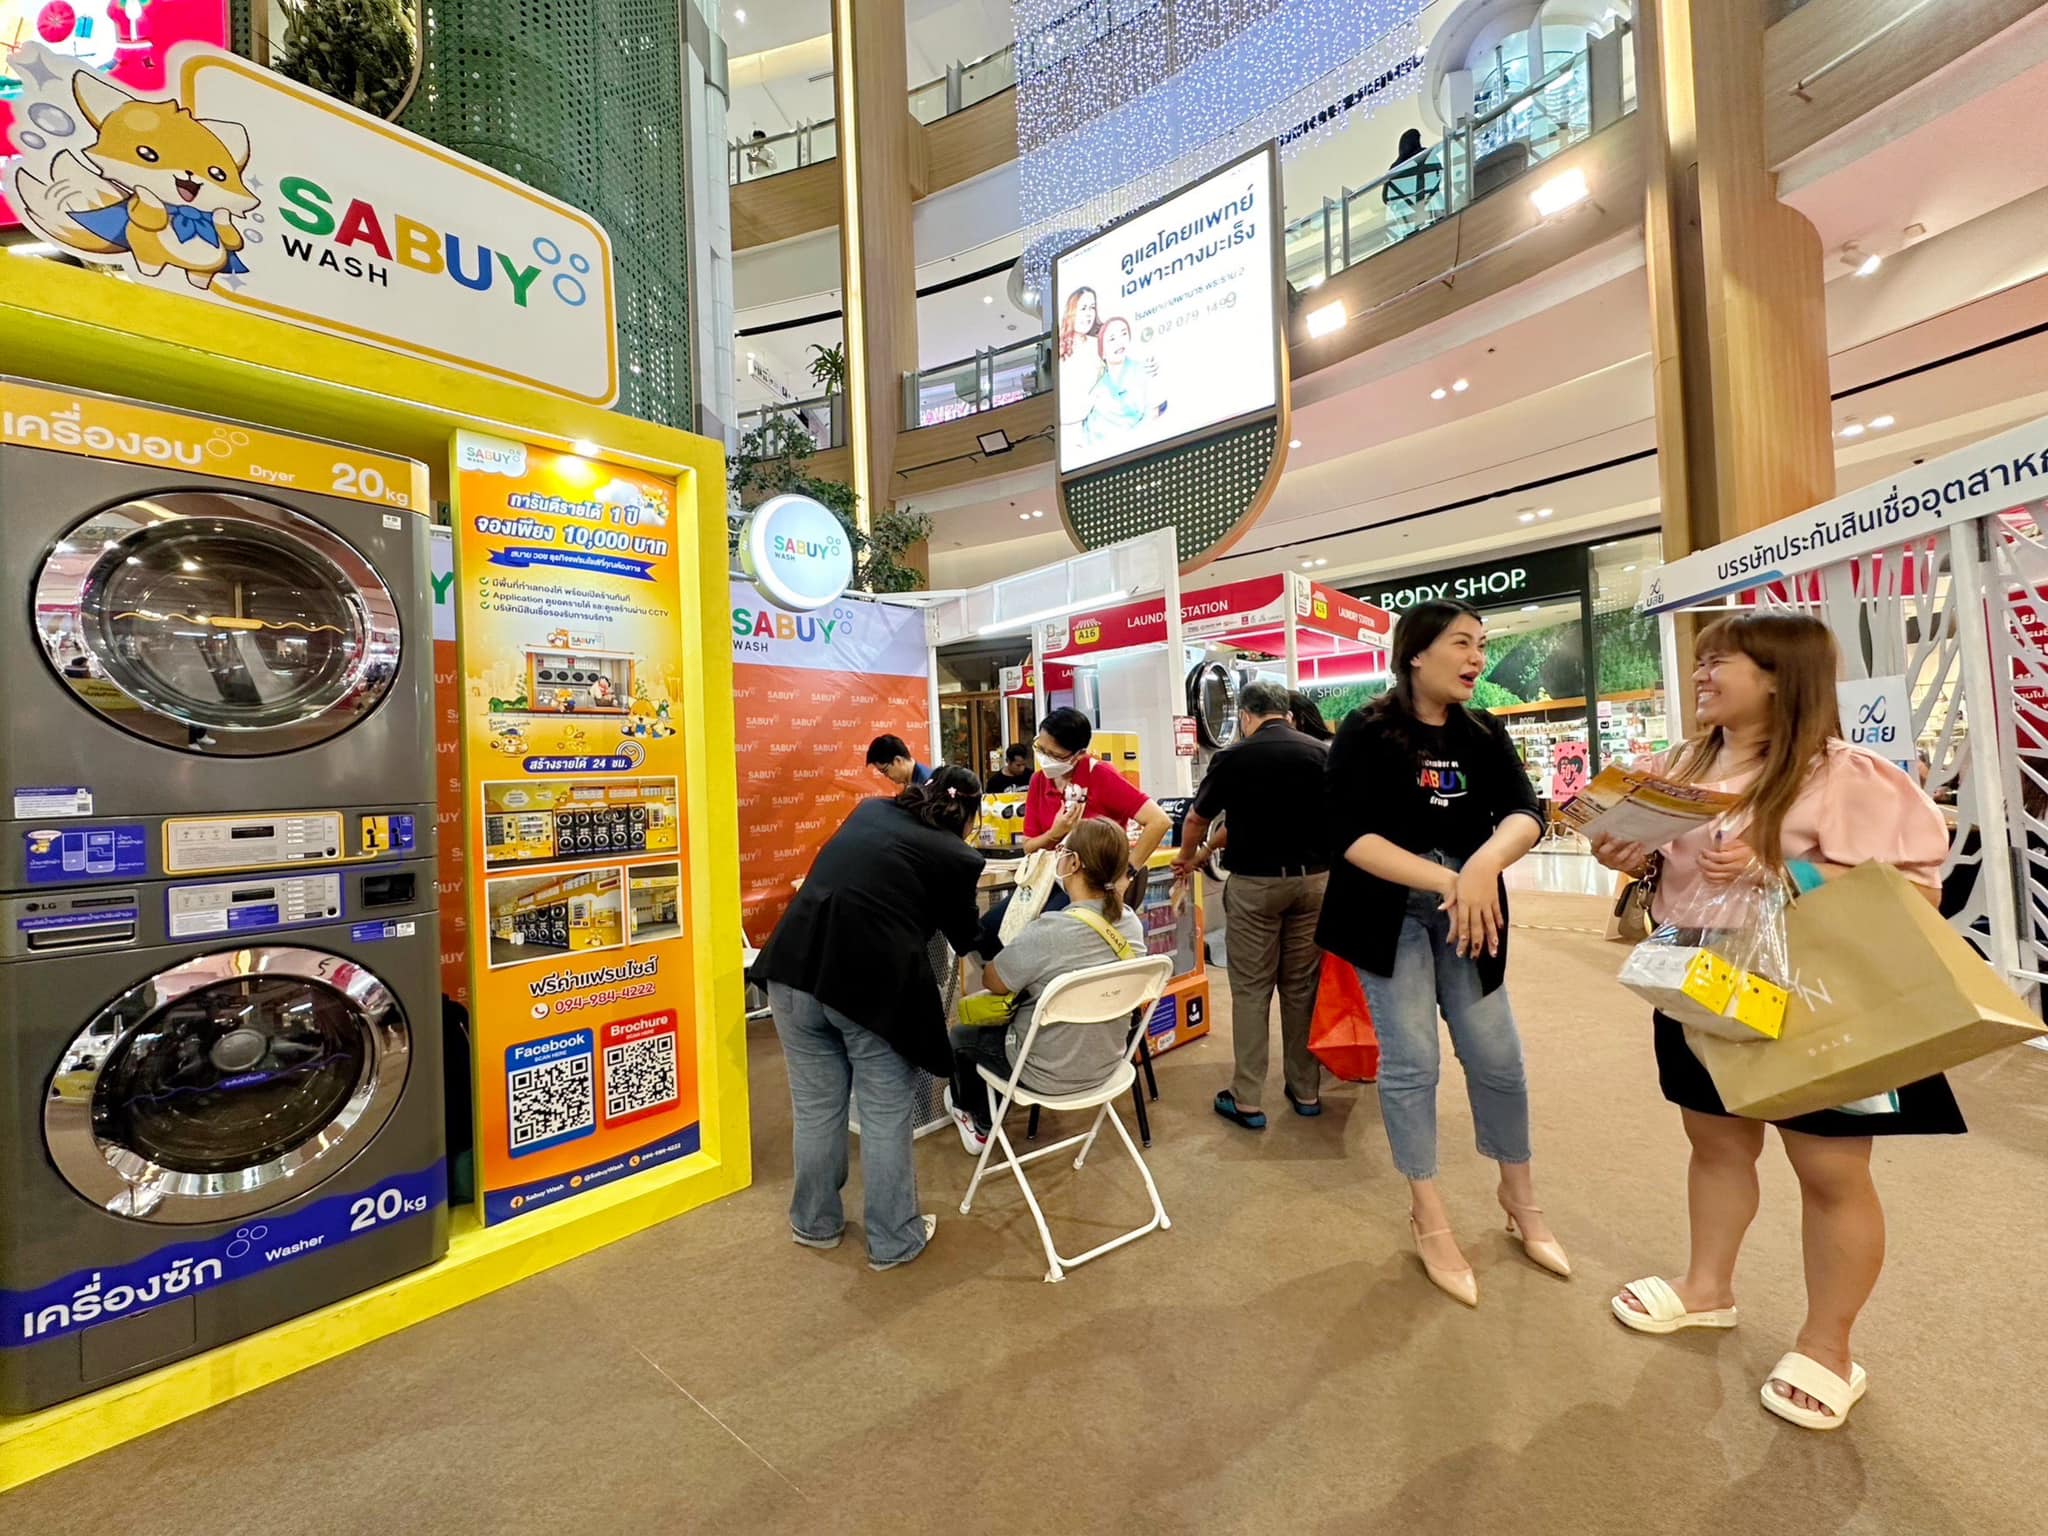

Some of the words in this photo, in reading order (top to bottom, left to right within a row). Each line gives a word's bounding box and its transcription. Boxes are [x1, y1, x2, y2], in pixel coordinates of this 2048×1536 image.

[278, 176, 542, 307] SABUY
[1121, 183, 1255, 275] ดูแลโดยแพทย์
[281, 235, 389, 287] WASH
[1121, 220, 1256, 298] เฉพาะทางมะเร็ง
[4, 403, 202, 465] เครื่องอบ
[467, 446, 510, 464] SABUY
[250, 464, 295, 482] Dryer
[611, 507, 620, 523] 1
[624, 504, 640, 525] ปี
[475, 516, 554, 541] จองเพียง
[564, 525, 630, 550] 10,000
[632, 541, 667, 556] บาท
[774, 535, 829, 560] SABUY
[774, 552, 796, 560] WASH
[493, 592, 543, 604] Application
[648, 609, 669, 617] CCTV
[1381, 582, 1448, 611] BODY
[732, 608, 836, 644] SABUY
[1128, 612, 1168, 628] LAUND
[1181, 600, 1229, 618] STATION
[733, 640, 768, 652] WASH
[1078, 629, 1096, 640] A16
[1852, 723, 1896, 744] บสย
[529, 756, 587, 770] สร้างรายได้
[592, 758, 606, 769] 24
[612, 757, 628, 769] ชม.
[1416, 768, 1467, 790] ABUY
[41, 902, 57, 910] LG
[1105, 928, 1127, 951] COAC
[529, 955, 658, 997] ฟรีค่าแฟรนไชส์
[555, 983, 656, 1014] 094-984-4222
[610, 1015, 668, 1037] Brochure
[514, 1033, 585, 1060] Facebook
[265, 1235, 325, 1262] Washer
[24, 1257, 222, 1338] เครื่องซัก
